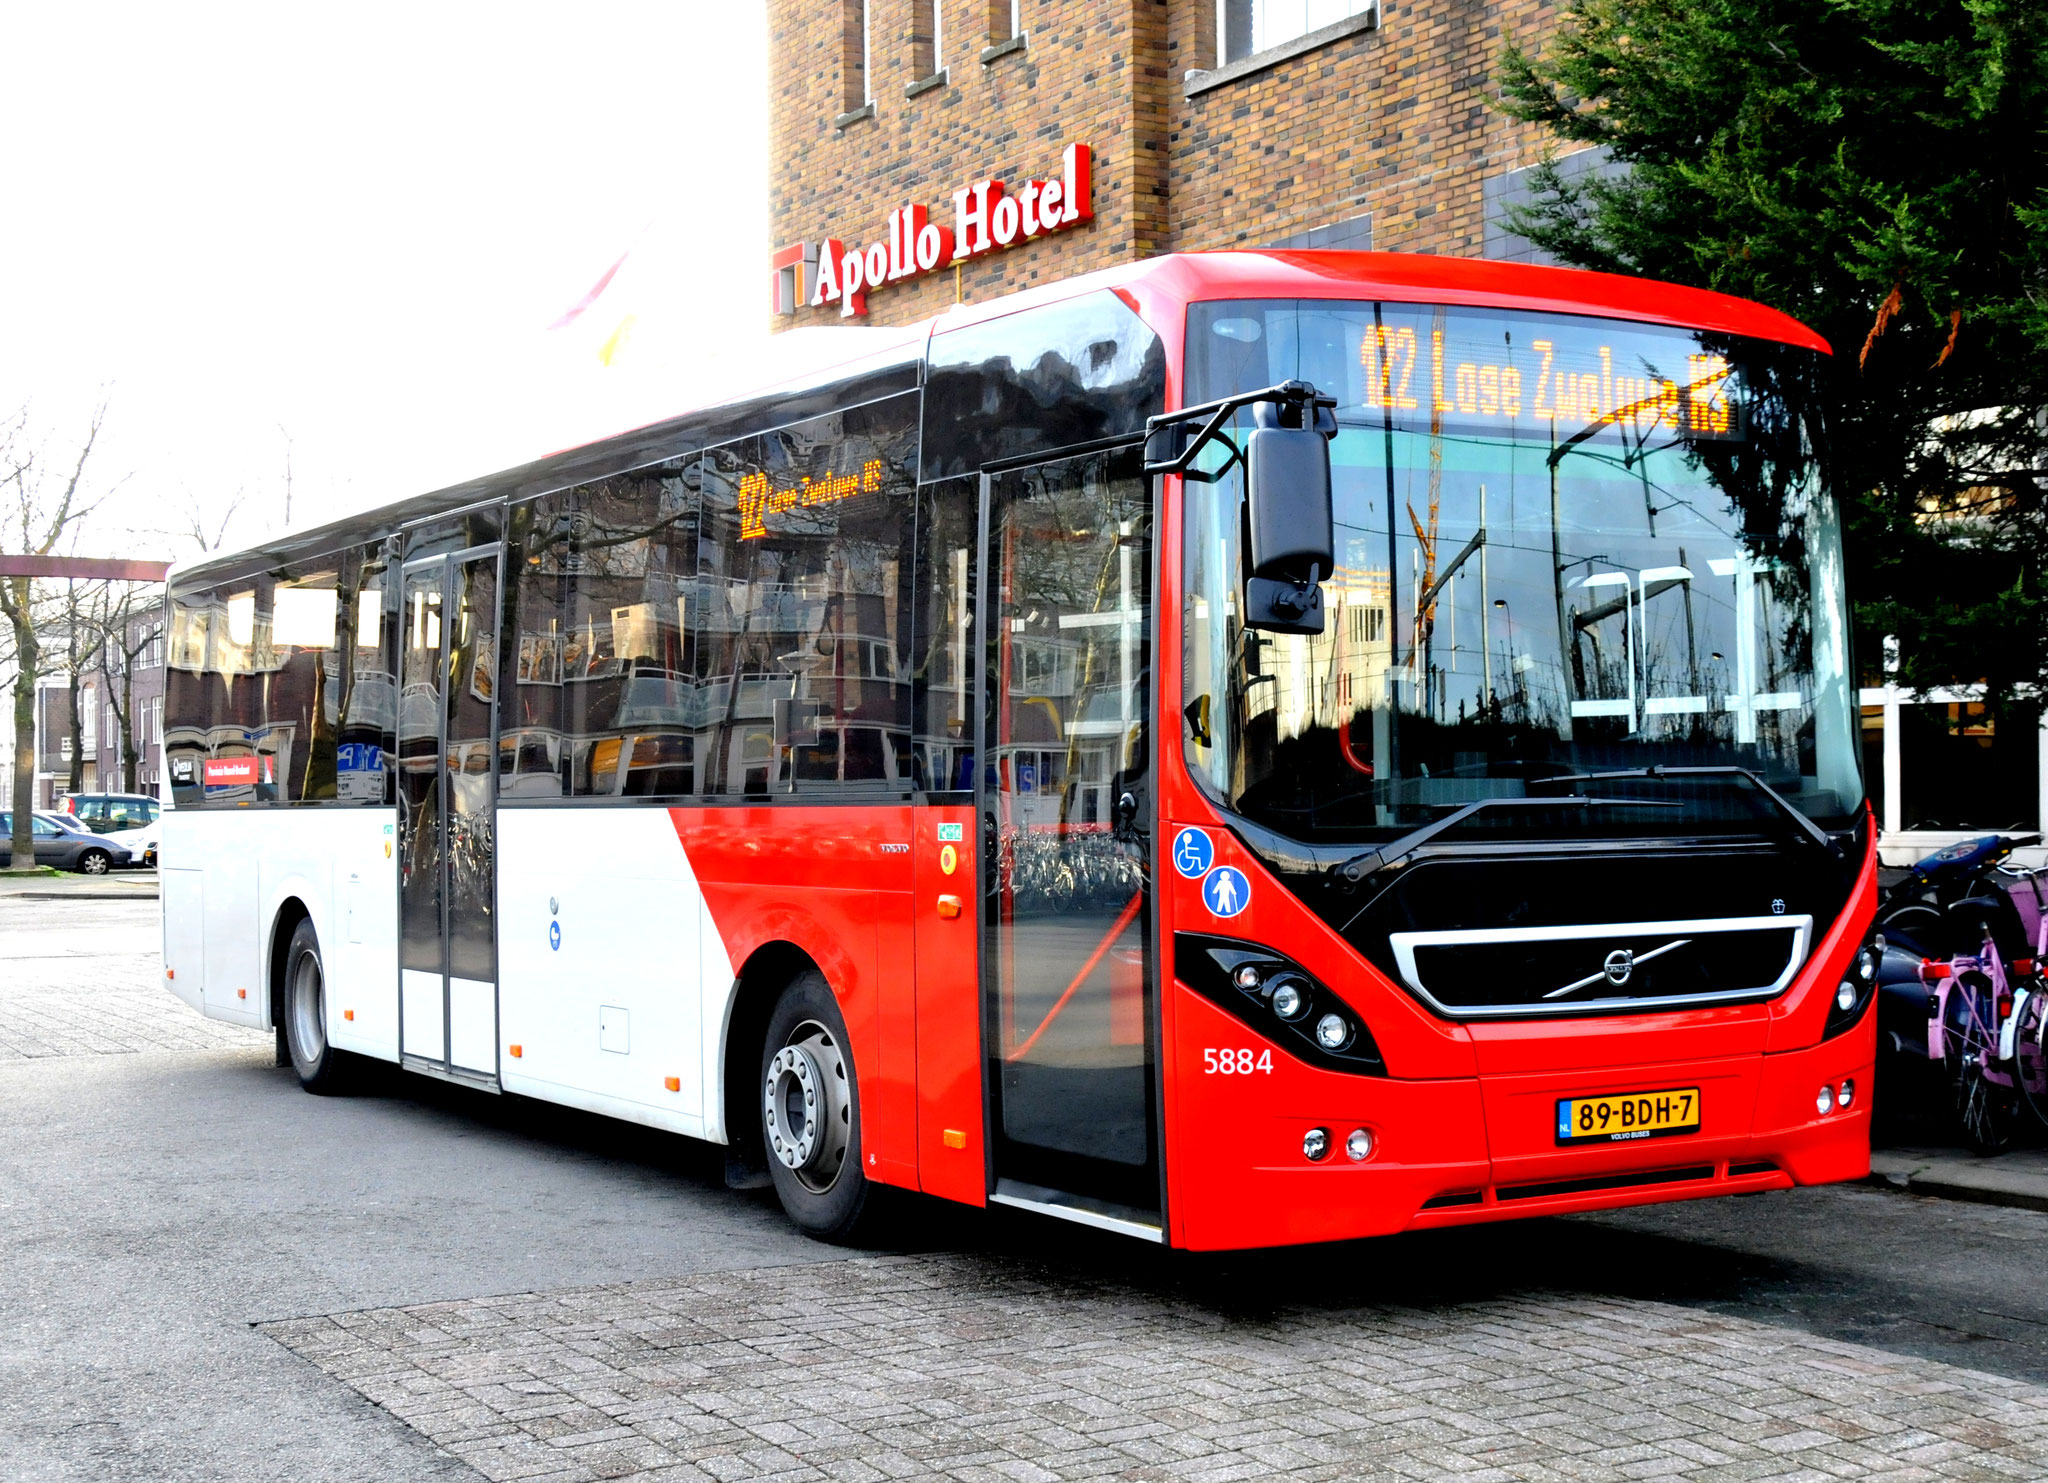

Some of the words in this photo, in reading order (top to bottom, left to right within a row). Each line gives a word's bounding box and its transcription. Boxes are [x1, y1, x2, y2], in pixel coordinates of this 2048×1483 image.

[811, 204, 953, 318] Apollo
[952, 142, 1091, 260] Hotel
[1361, 324, 1417, 408] 122
[1204, 1048, 1274, 1075] 5884
[1559, 1123, 1570, 1132] NL
[1579, 1095, 1692, 1130] 89-BDH-7
